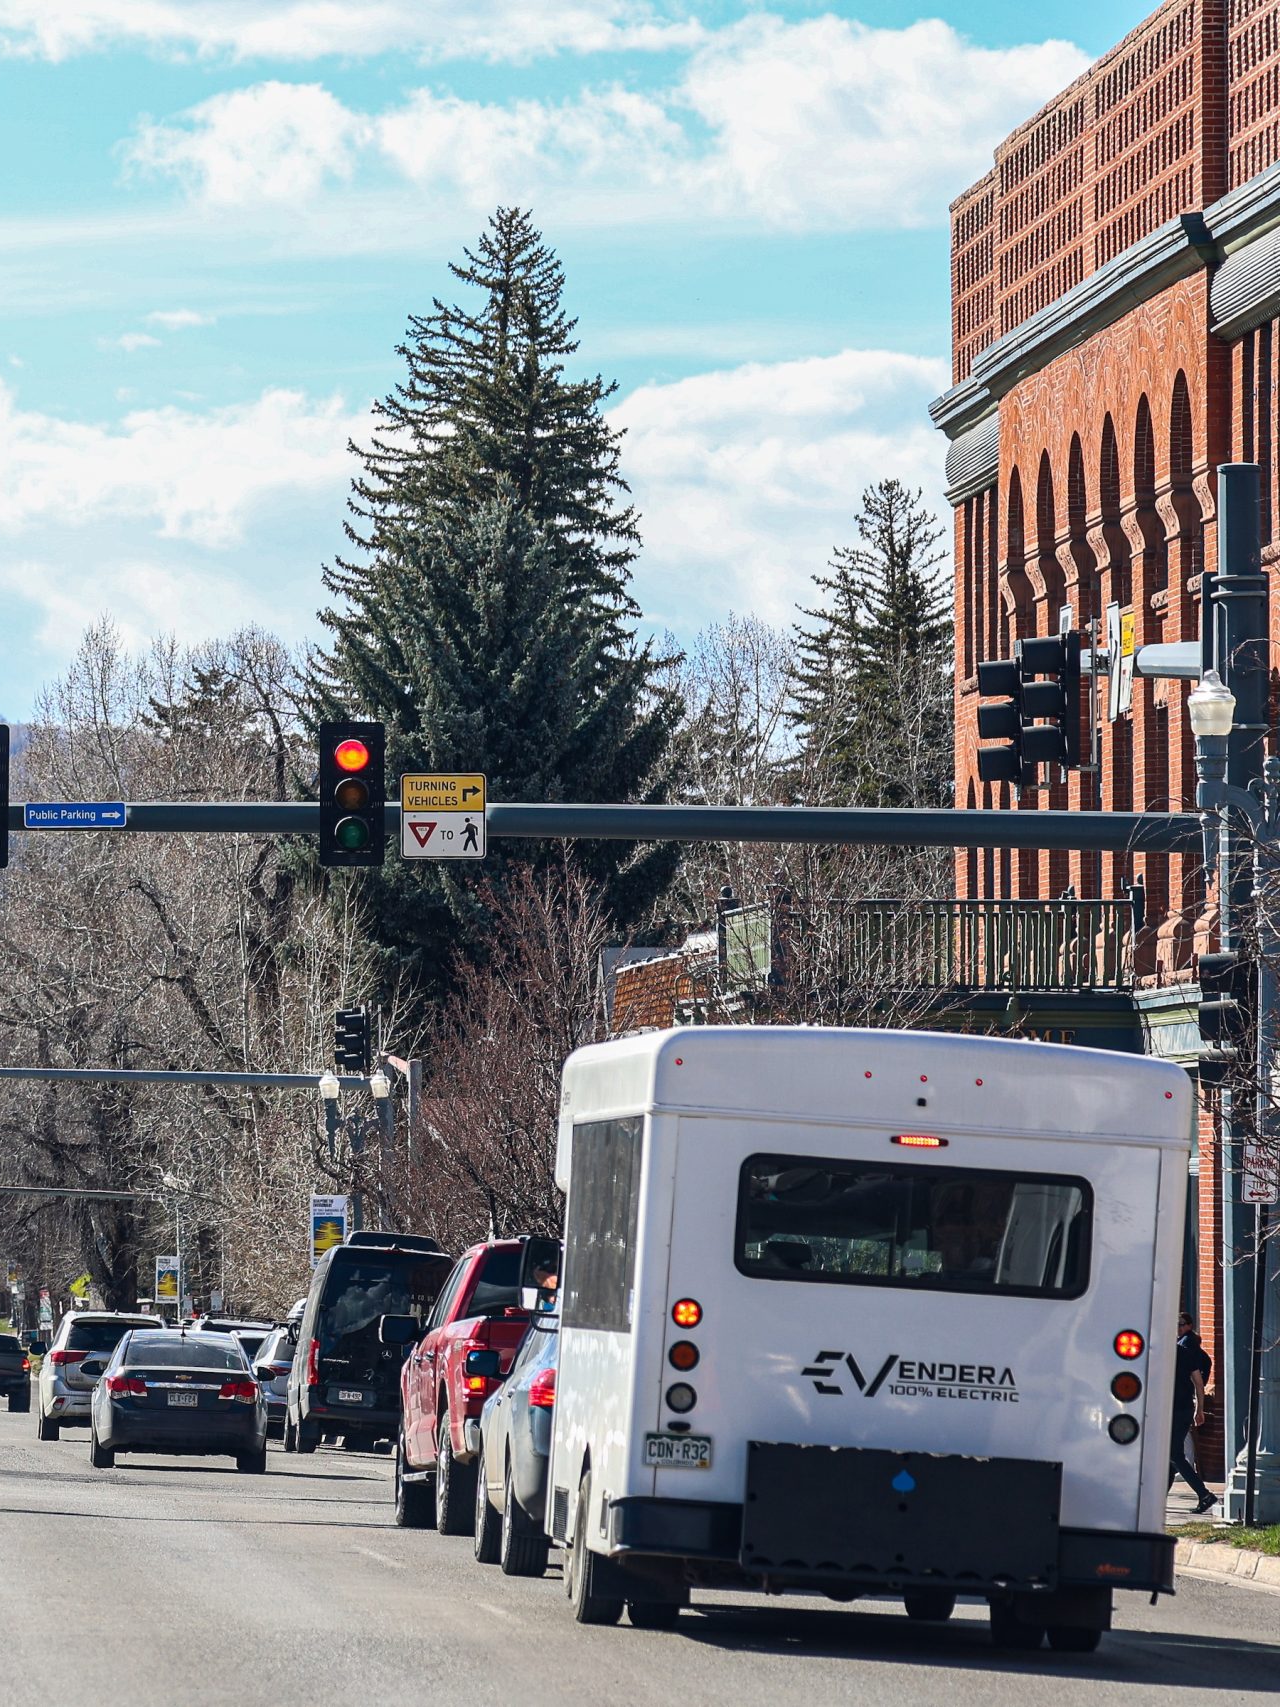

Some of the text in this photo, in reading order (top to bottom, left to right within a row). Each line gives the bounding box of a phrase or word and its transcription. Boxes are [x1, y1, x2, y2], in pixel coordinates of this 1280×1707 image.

[408, 781, 456, 791] TURNING
[407, 796, 458, 806] VEHICLES
[29, 809, 96, 821] Public Parking
[440, 830, 454, 840] TO
[888, 1384, 1020, 1402] 100% ELECTRIC
